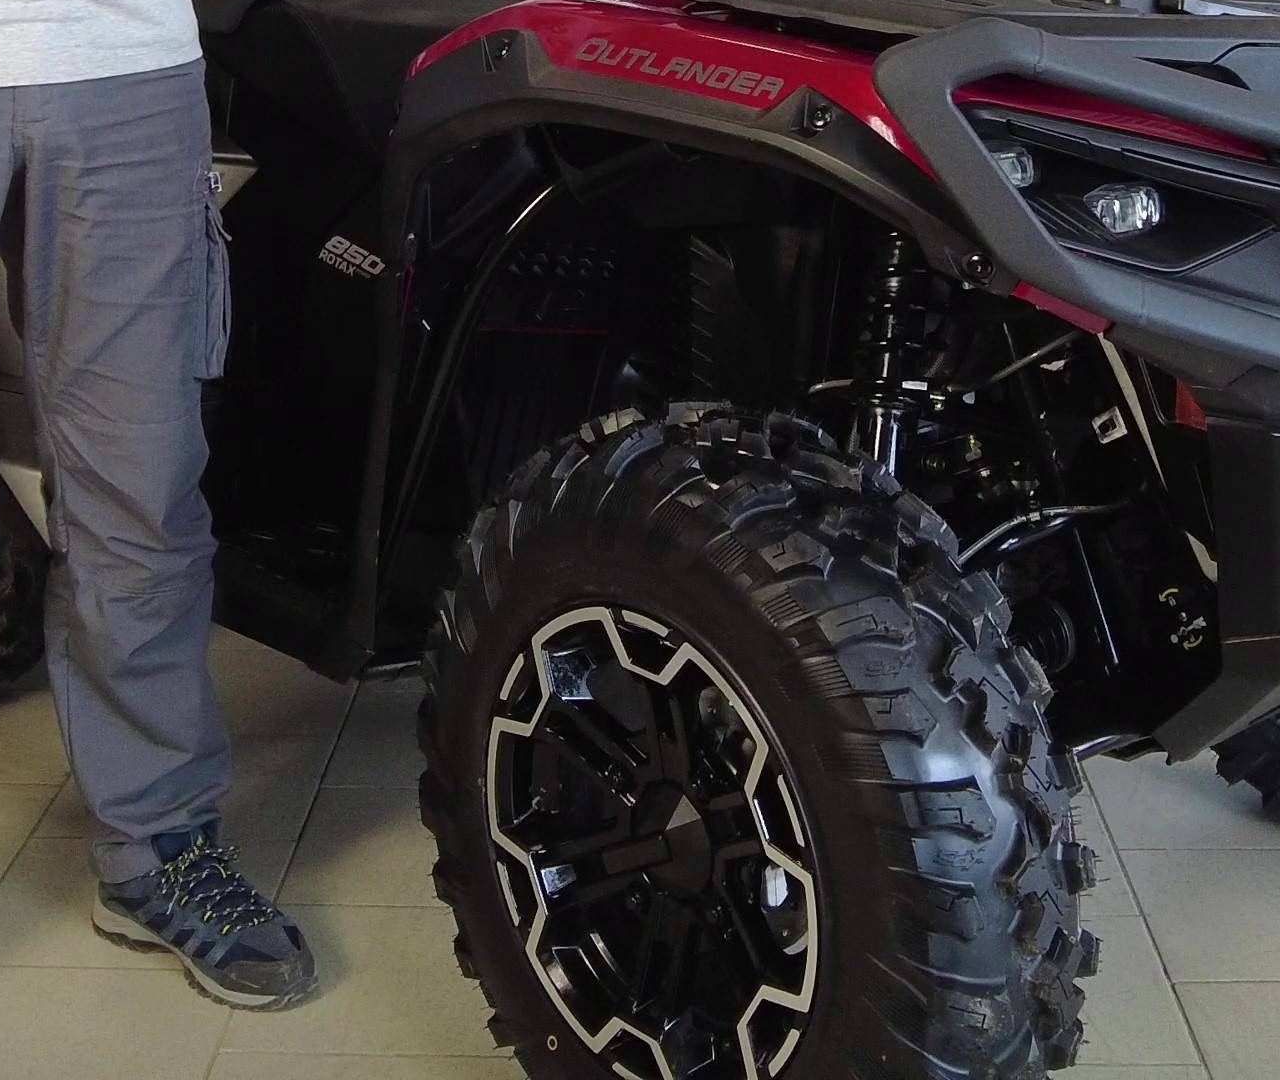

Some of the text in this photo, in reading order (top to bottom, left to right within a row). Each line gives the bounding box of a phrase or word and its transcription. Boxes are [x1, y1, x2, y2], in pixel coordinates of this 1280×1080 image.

[576, 38, 784, 100] OUTLANDER
[318, 248, 357, 277] ROTAX
[324, 235, 386, 276] 850
